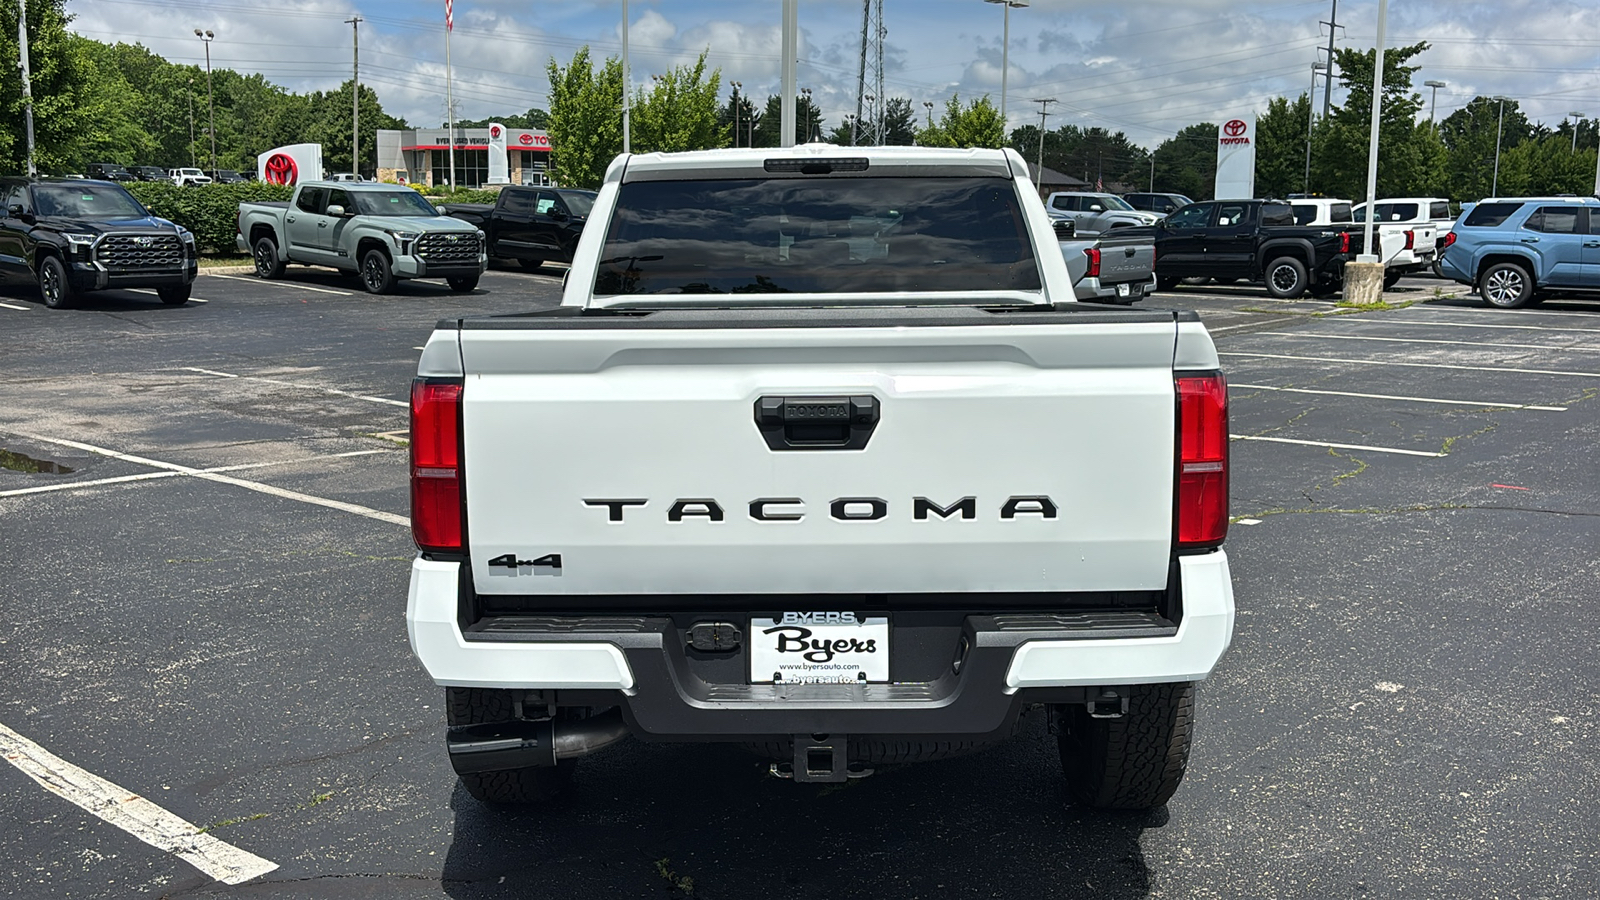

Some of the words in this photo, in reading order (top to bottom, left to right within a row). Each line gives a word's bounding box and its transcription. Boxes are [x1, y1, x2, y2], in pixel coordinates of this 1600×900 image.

[436, 137, 451, 145] BYER
[454, 137, 469, 145] USED
[1220, 137, 1250, 145] TOYOTA
[787, 405, 847, 417] TOYOTA
[582, 495, 1060, 522] TACOMA
[783, 611, 856, 624] BYERS
[762, 626, 876, 663] Byers
[779, 663, 860, 671] www.byersauto.com
[774, 674, 867, 685] www.byersauto.com
